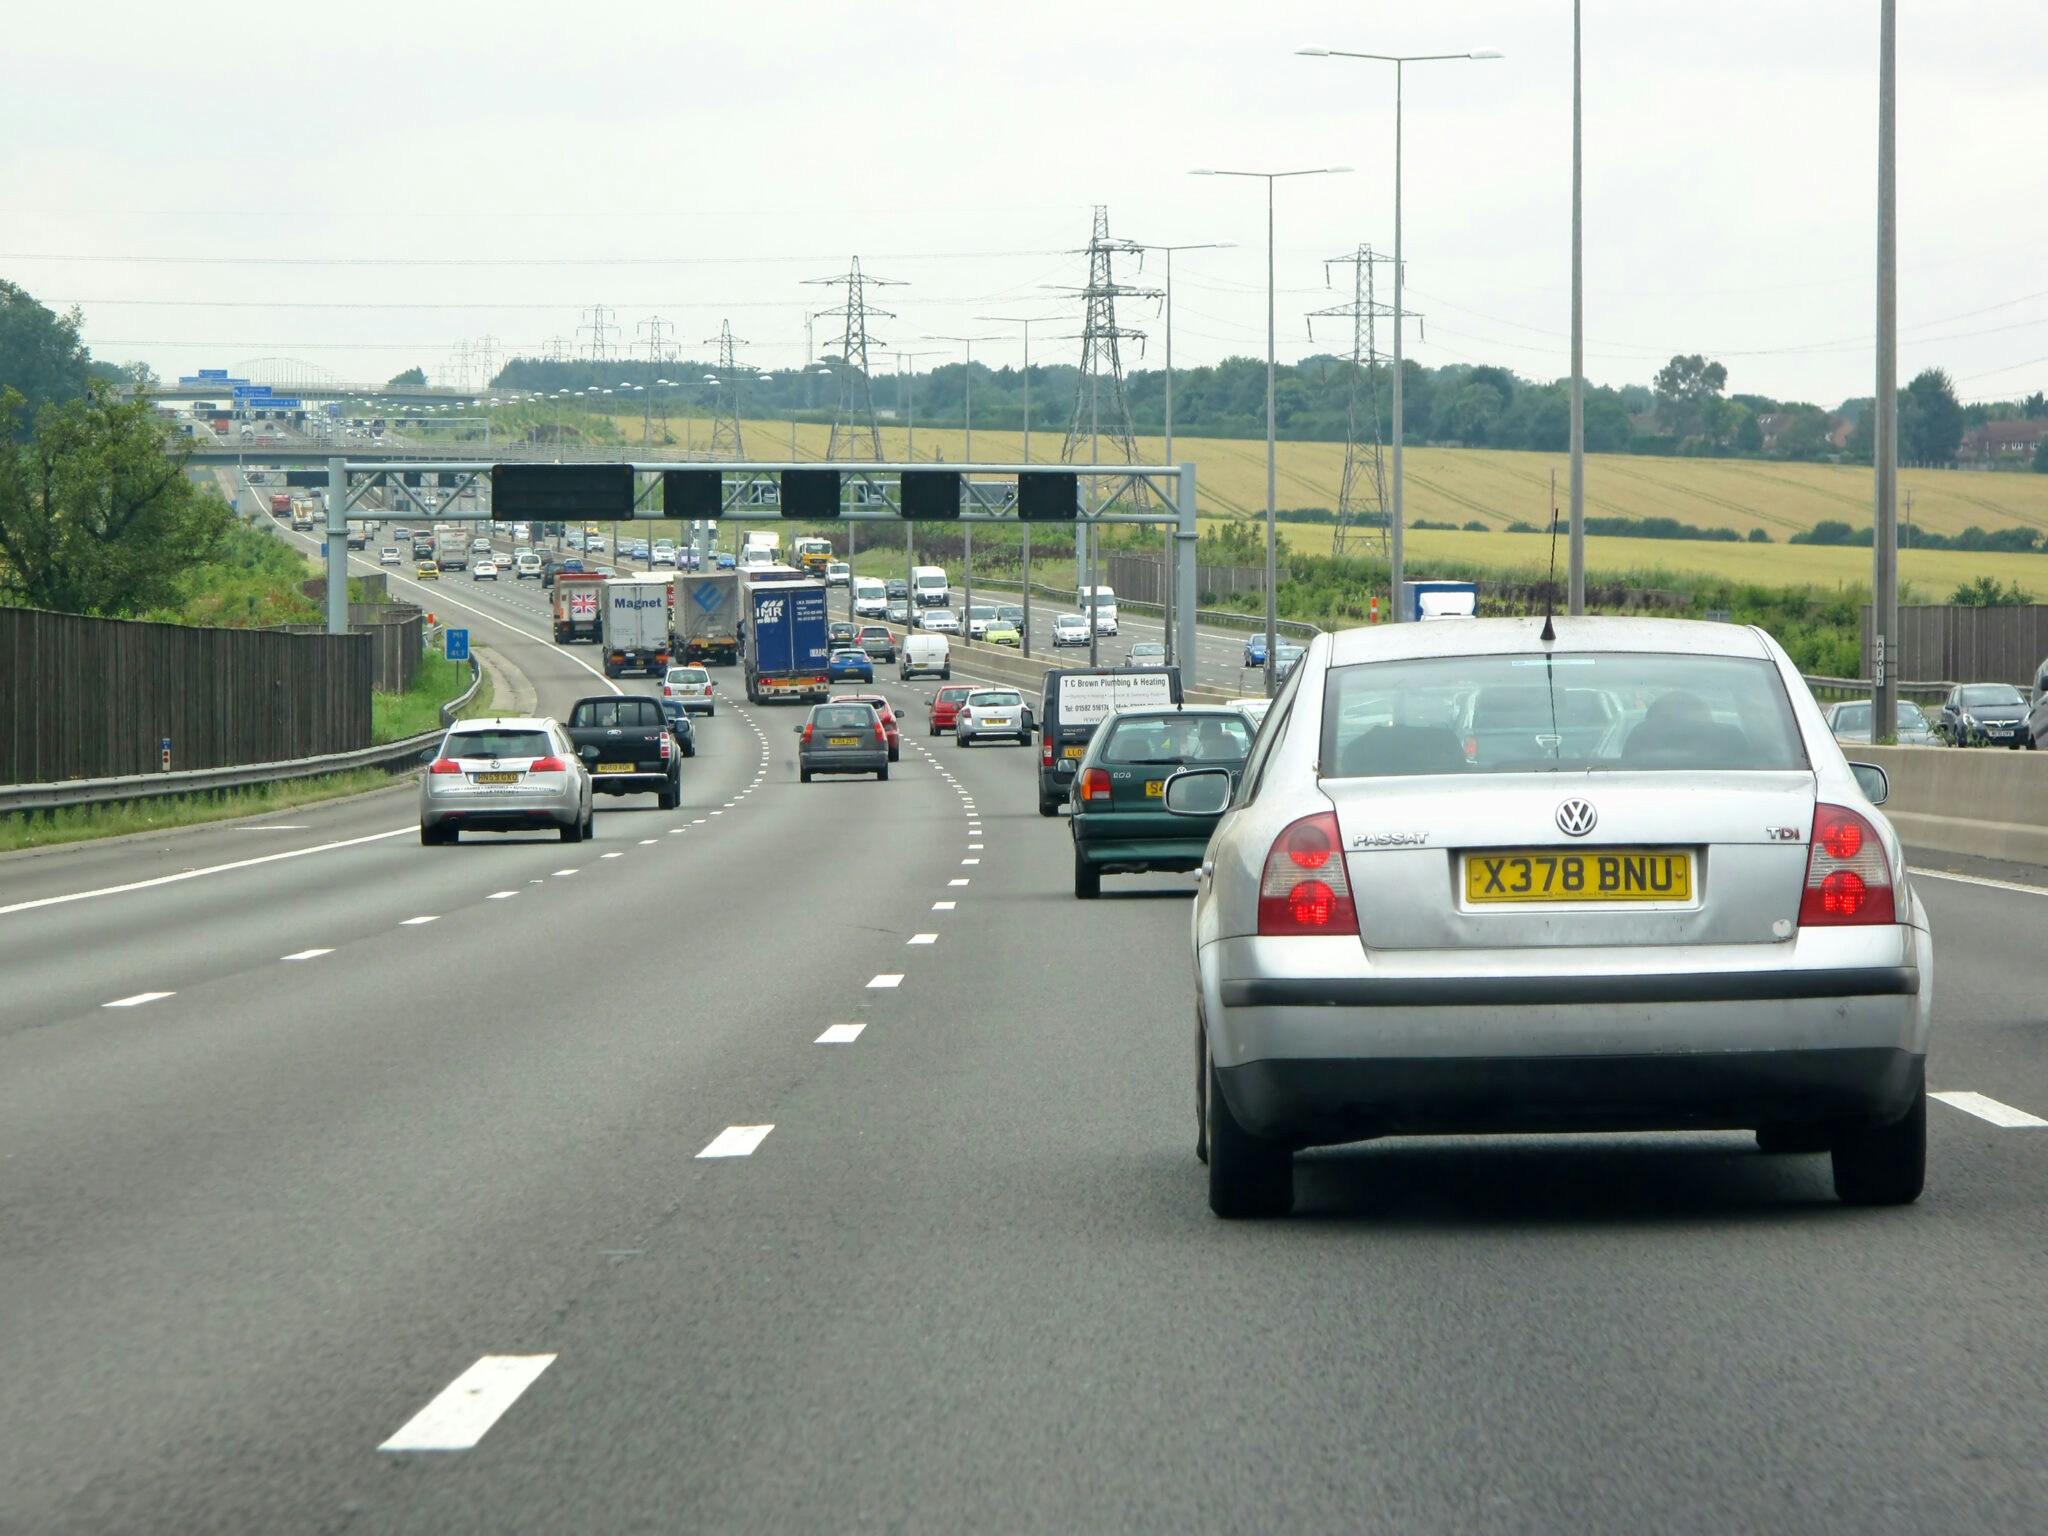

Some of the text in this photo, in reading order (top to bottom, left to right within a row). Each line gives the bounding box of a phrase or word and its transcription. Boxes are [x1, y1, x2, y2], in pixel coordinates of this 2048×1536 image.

[614, 598, 662, 610] Magnet
[1100, 679, 1131, 687] Plumbing
[1140, 678, 1166, 687] Heating
[1353, 832, 1429, 847] PASSAT
[1766, 827, 1800, 840] TDI
[1484, 857, 1672, 893] X378 BNU
